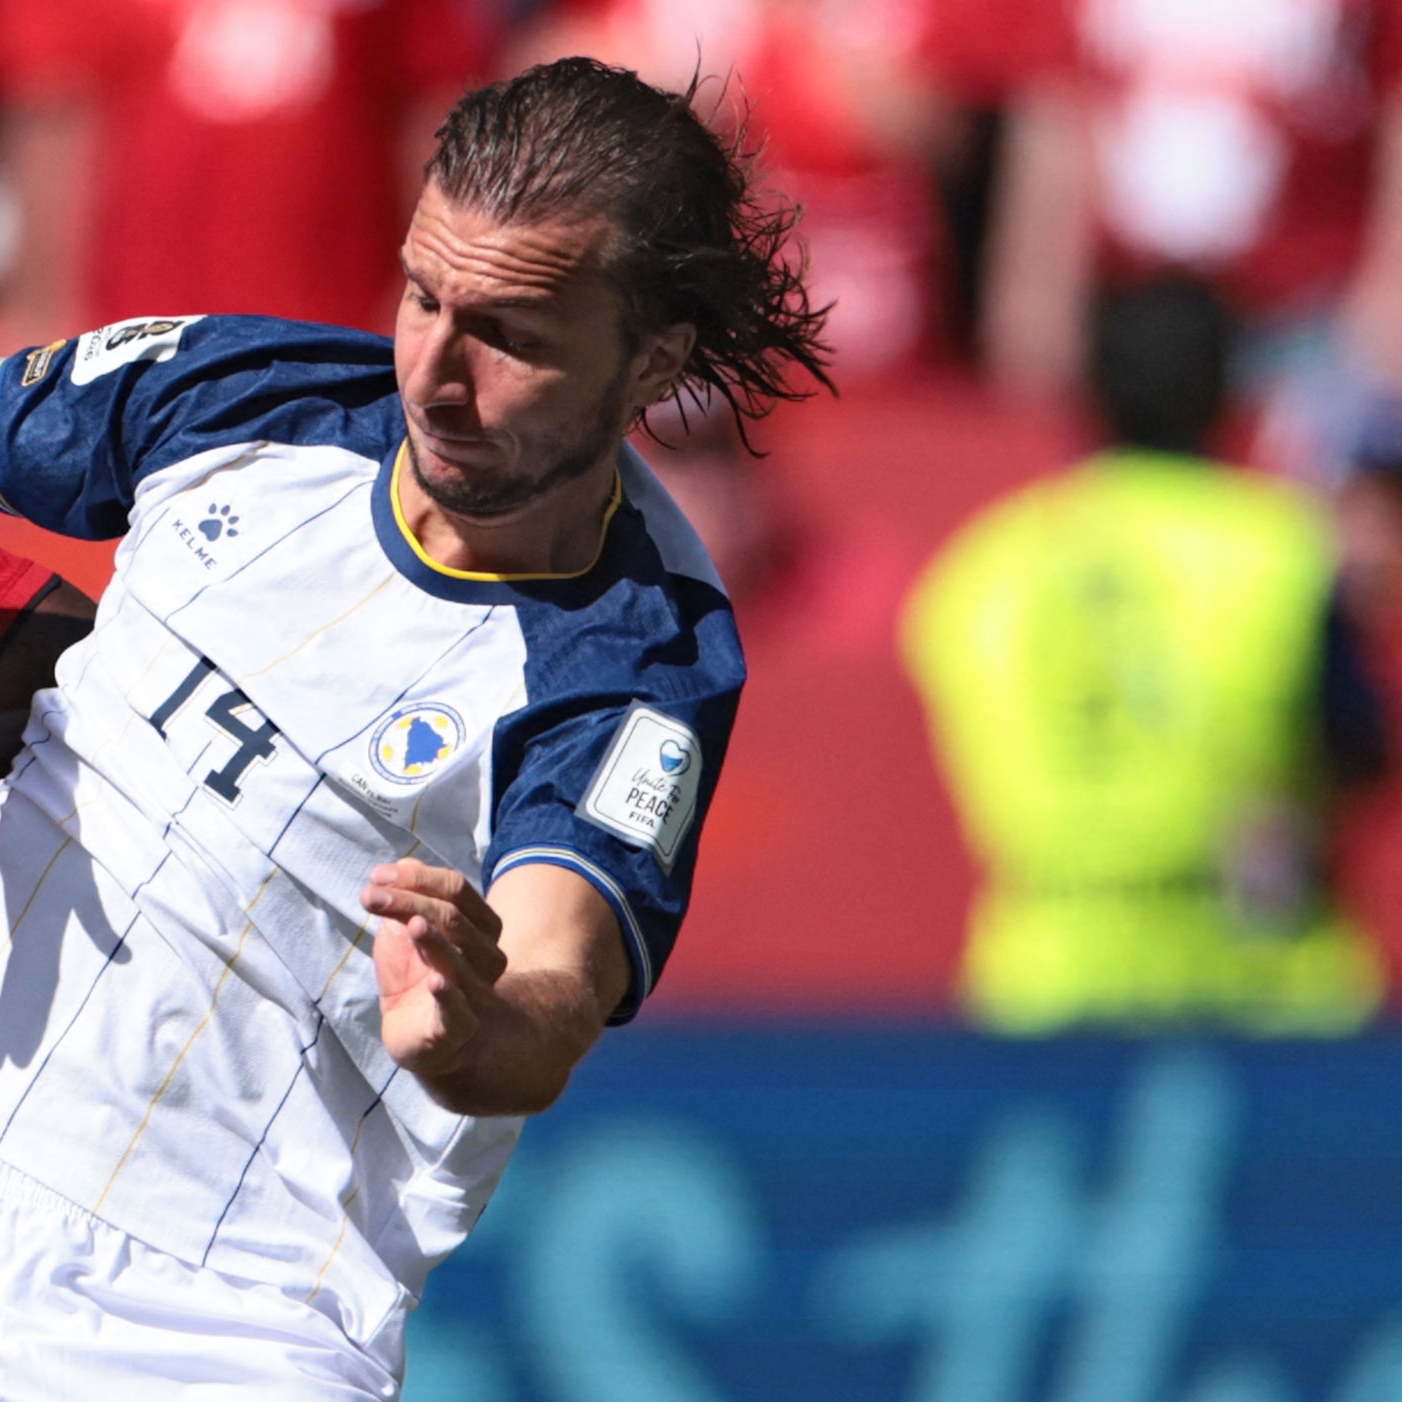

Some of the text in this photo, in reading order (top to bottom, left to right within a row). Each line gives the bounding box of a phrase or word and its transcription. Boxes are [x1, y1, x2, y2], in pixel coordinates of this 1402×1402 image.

[172, 519, 217, 571] KELME
[149, 655, 277, 804] 14
[625, 787, 673, 825] PEACE
[629, 811, 654, 828] FIFA
